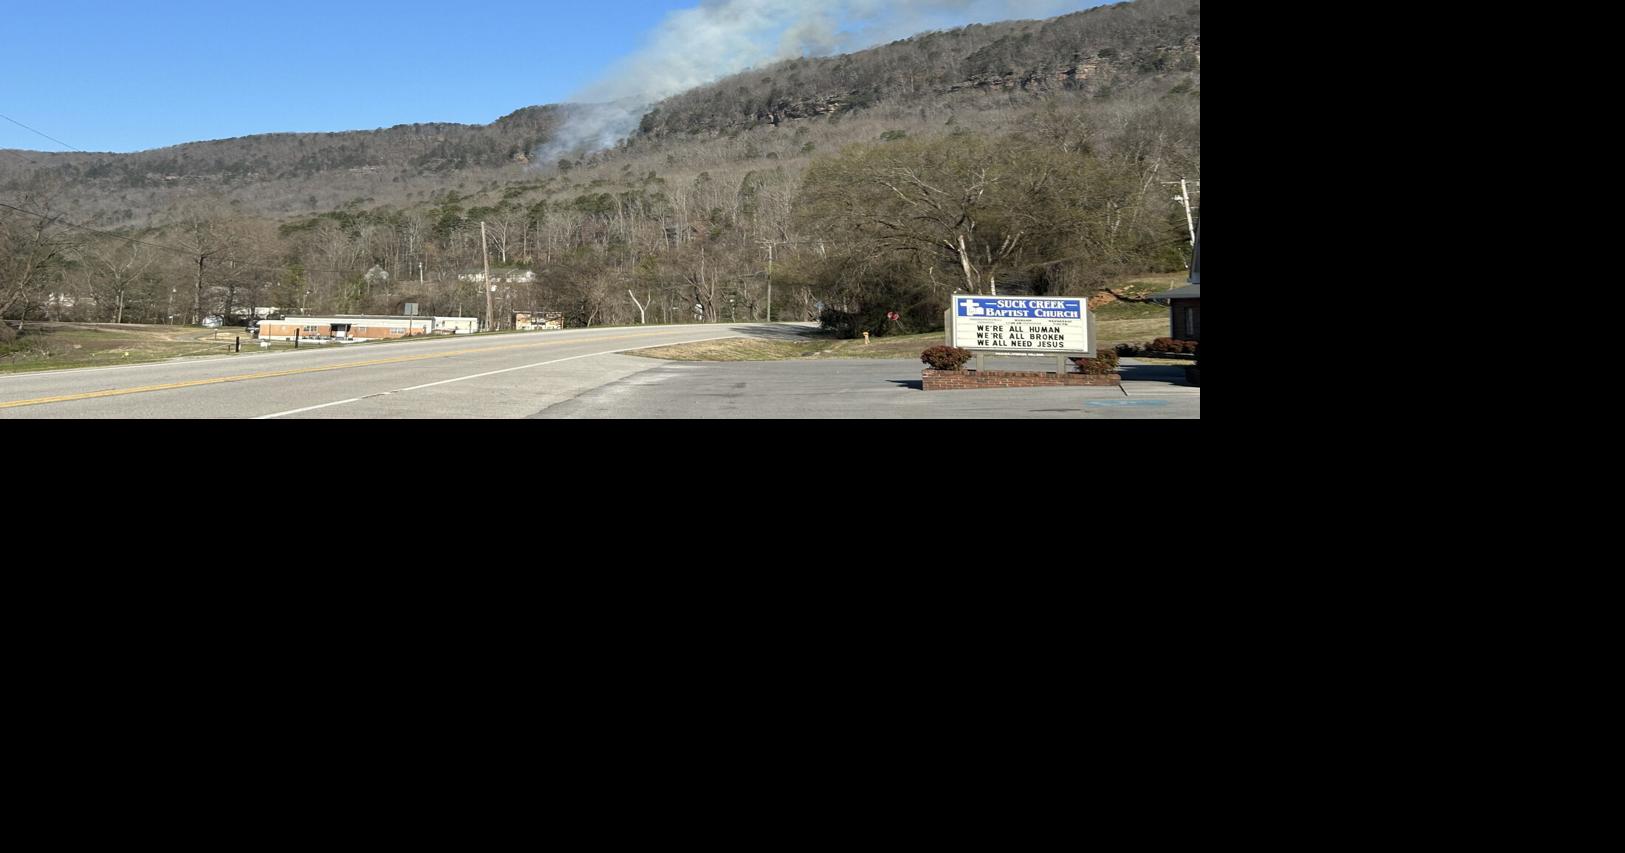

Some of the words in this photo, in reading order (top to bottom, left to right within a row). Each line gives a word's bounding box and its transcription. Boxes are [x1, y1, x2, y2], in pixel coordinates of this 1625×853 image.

[996, 300, 1026, 308] SUCK
[1028, 300, 1065, 309] CREEK
[986, 308, 1029, 316] BAPTIST
[1034, 309, 1078, 318] CHURCH
